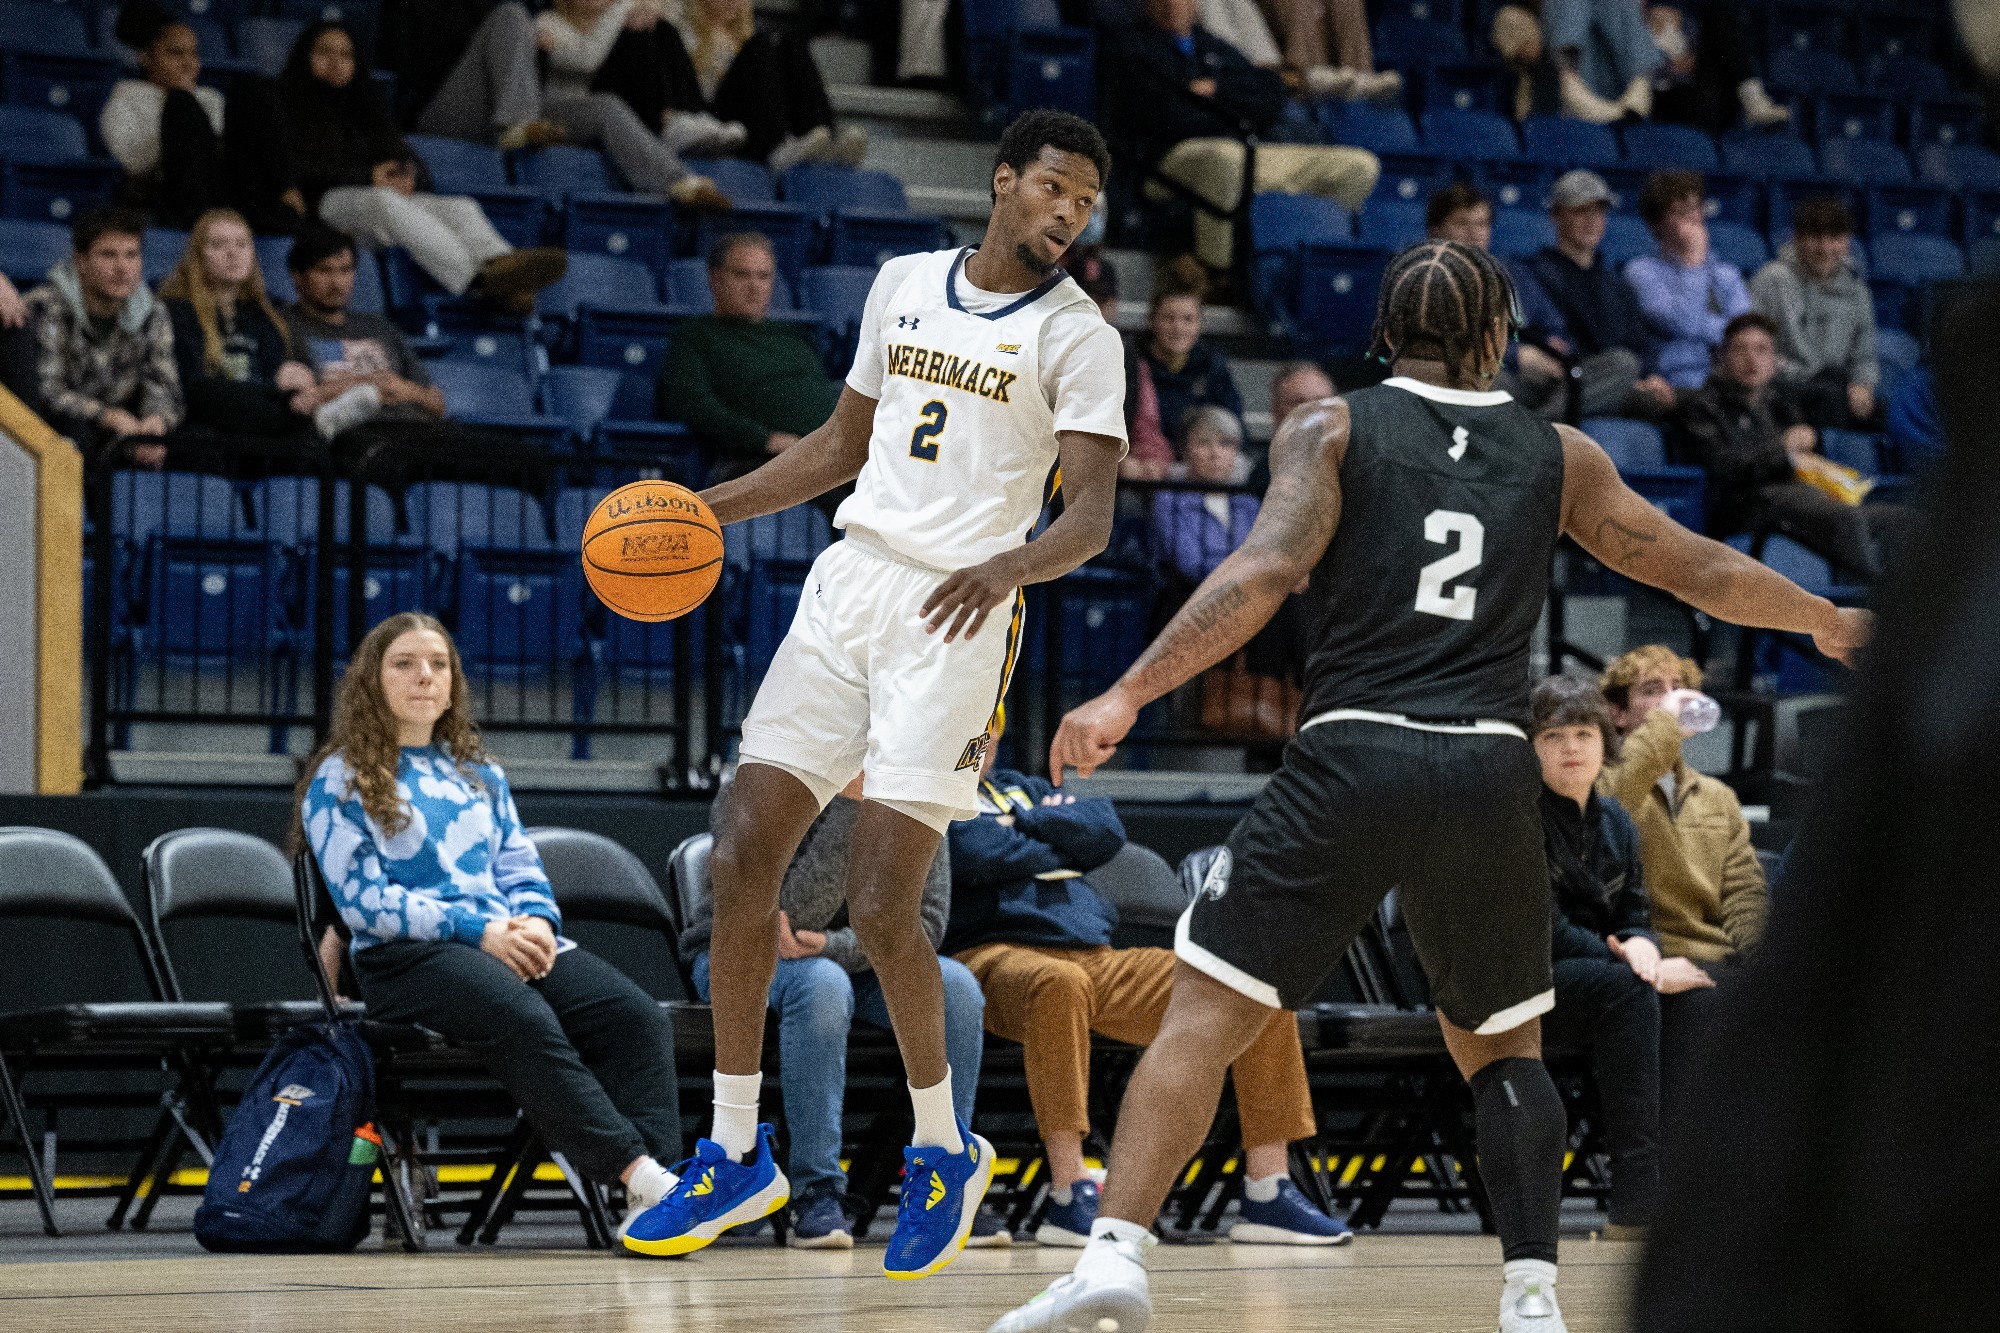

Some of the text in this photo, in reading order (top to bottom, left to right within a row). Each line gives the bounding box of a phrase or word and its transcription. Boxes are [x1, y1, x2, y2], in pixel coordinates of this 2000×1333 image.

[887, 343, 1018, 403] MERRIMACK
[909, 398, 949, 464] 2
[605, 491, 701, 519] Wilson
[1414, 508, 1485, 621] 2
